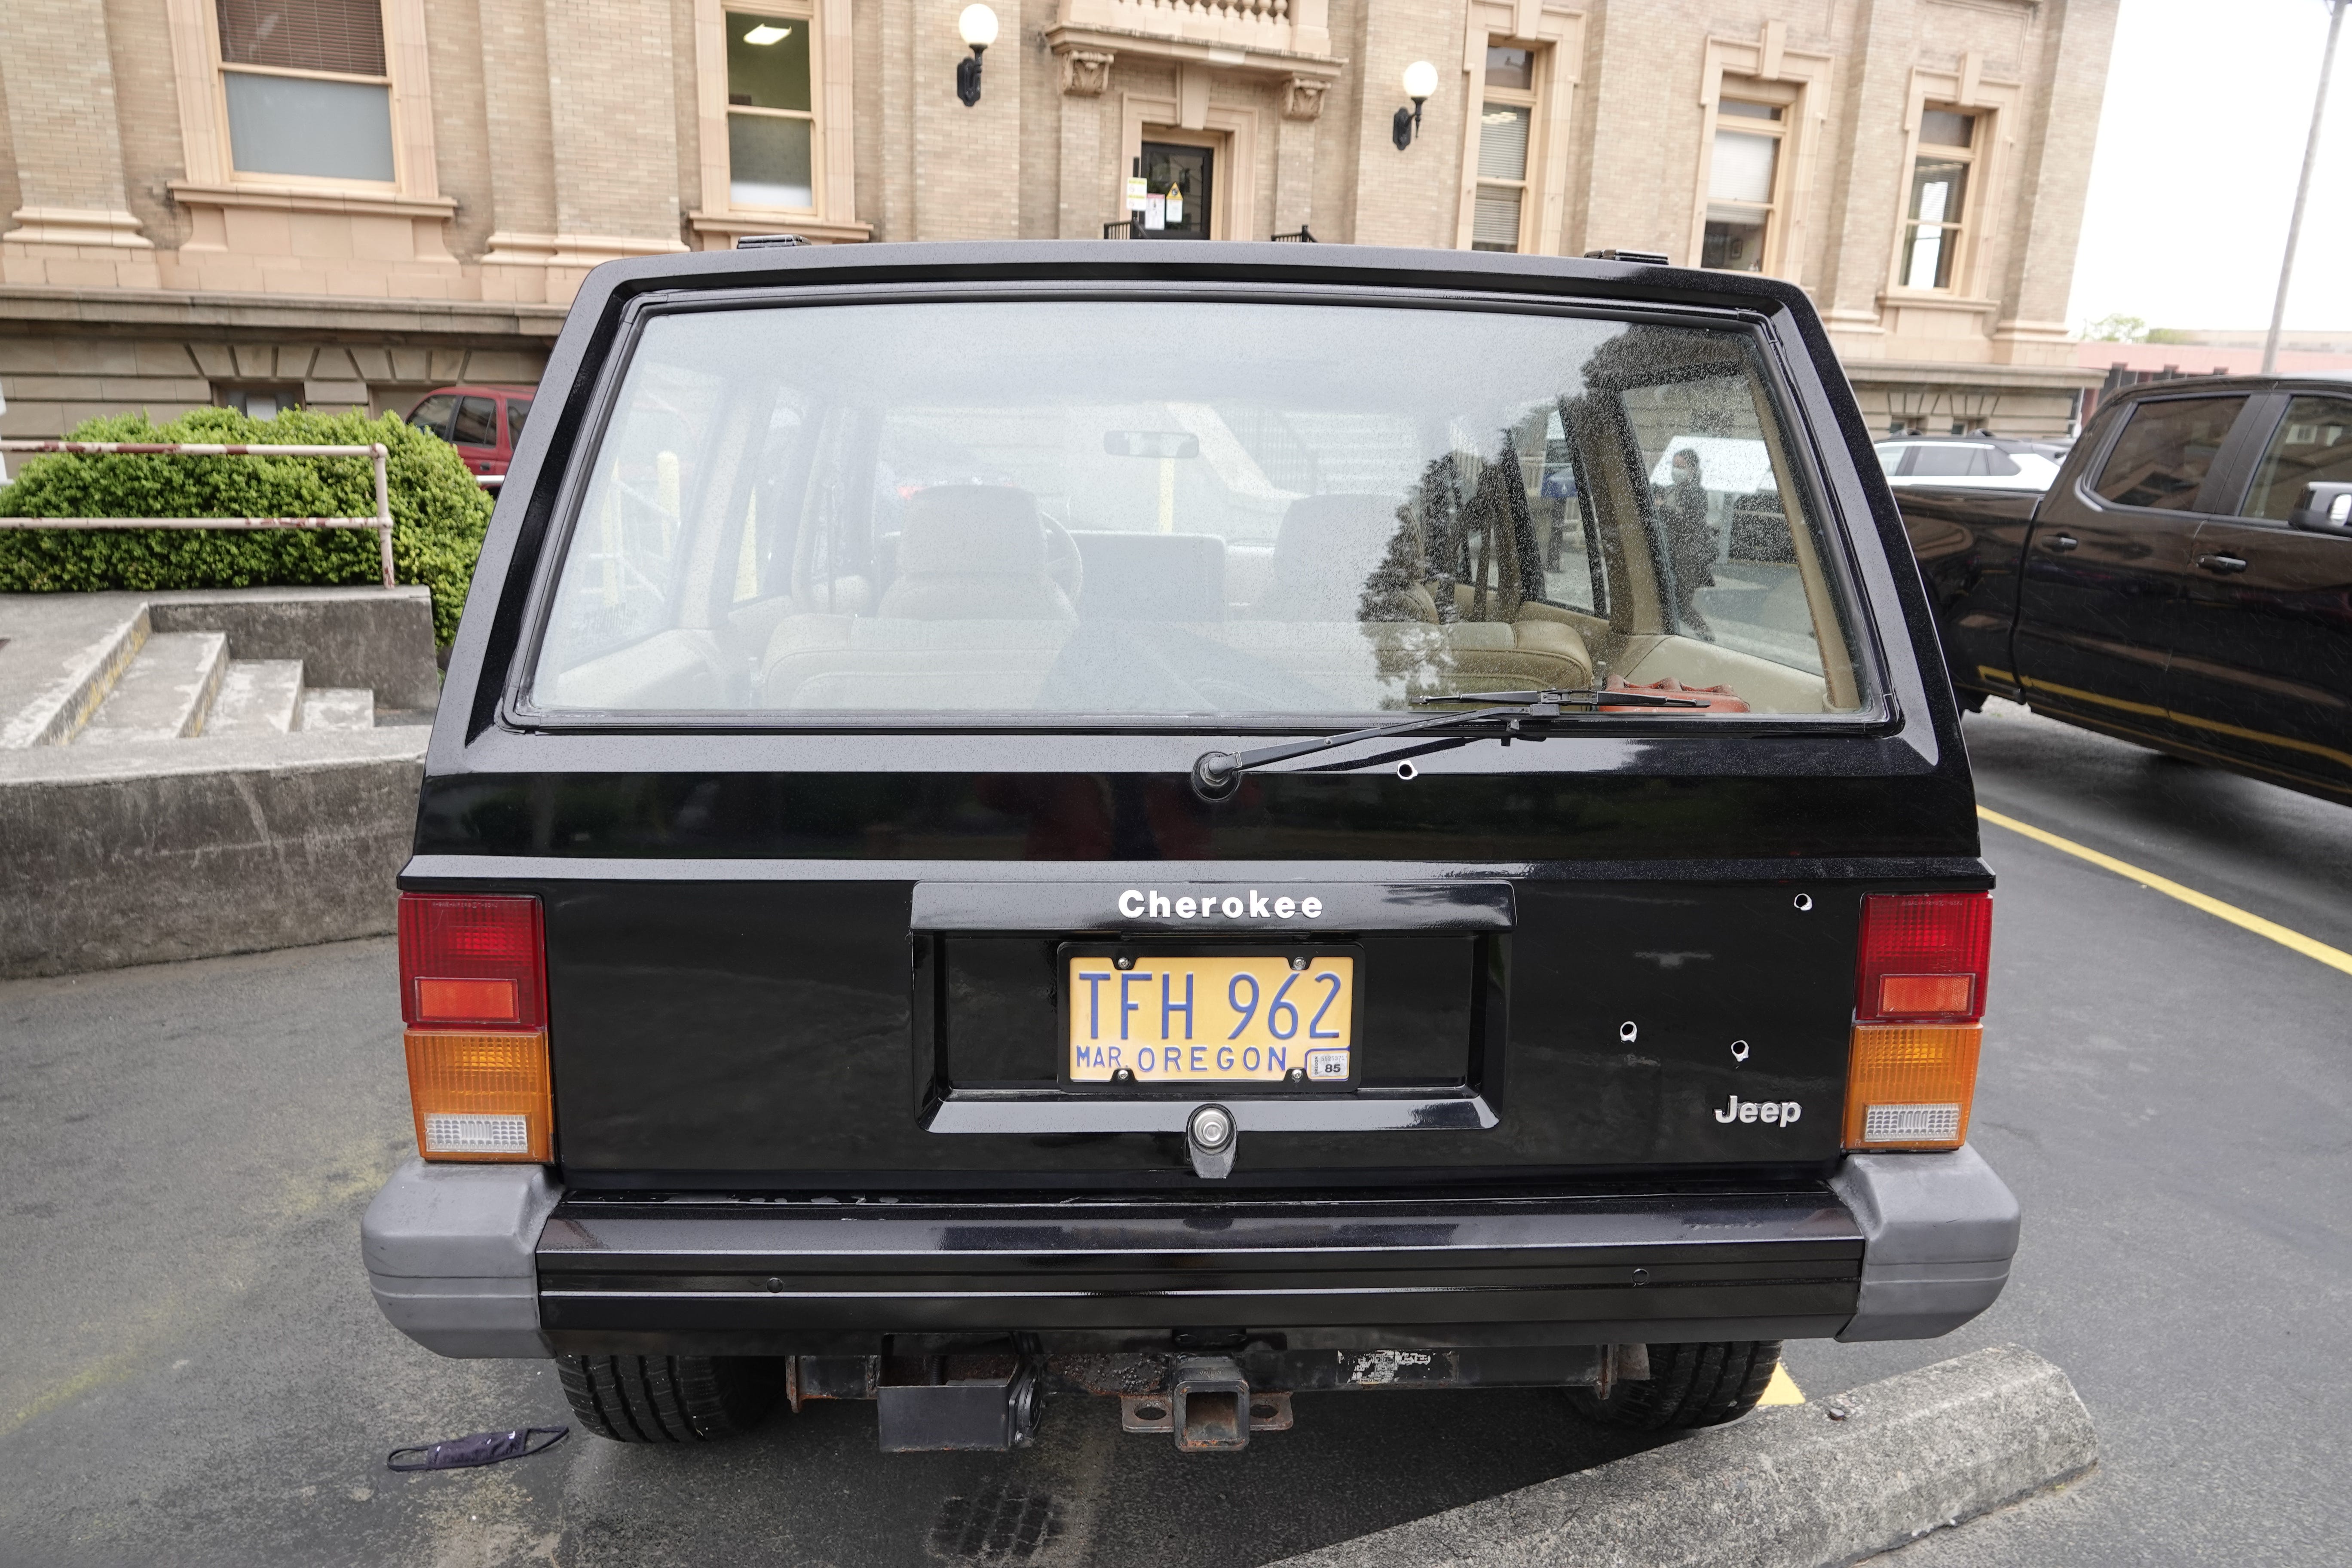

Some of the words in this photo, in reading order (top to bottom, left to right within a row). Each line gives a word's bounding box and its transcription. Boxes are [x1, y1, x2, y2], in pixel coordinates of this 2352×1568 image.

[1118, 890, 1323, 919] Cherokee
[1079, 972, 1193, 1039] TFH
[1228, 972, 1341, 1039] 962
[1137, 1046, 1286, 1072] OREGON
[1325, 1063, 1341, 1073] 85
[1714, 1094, 1802, 1127] Jeep
